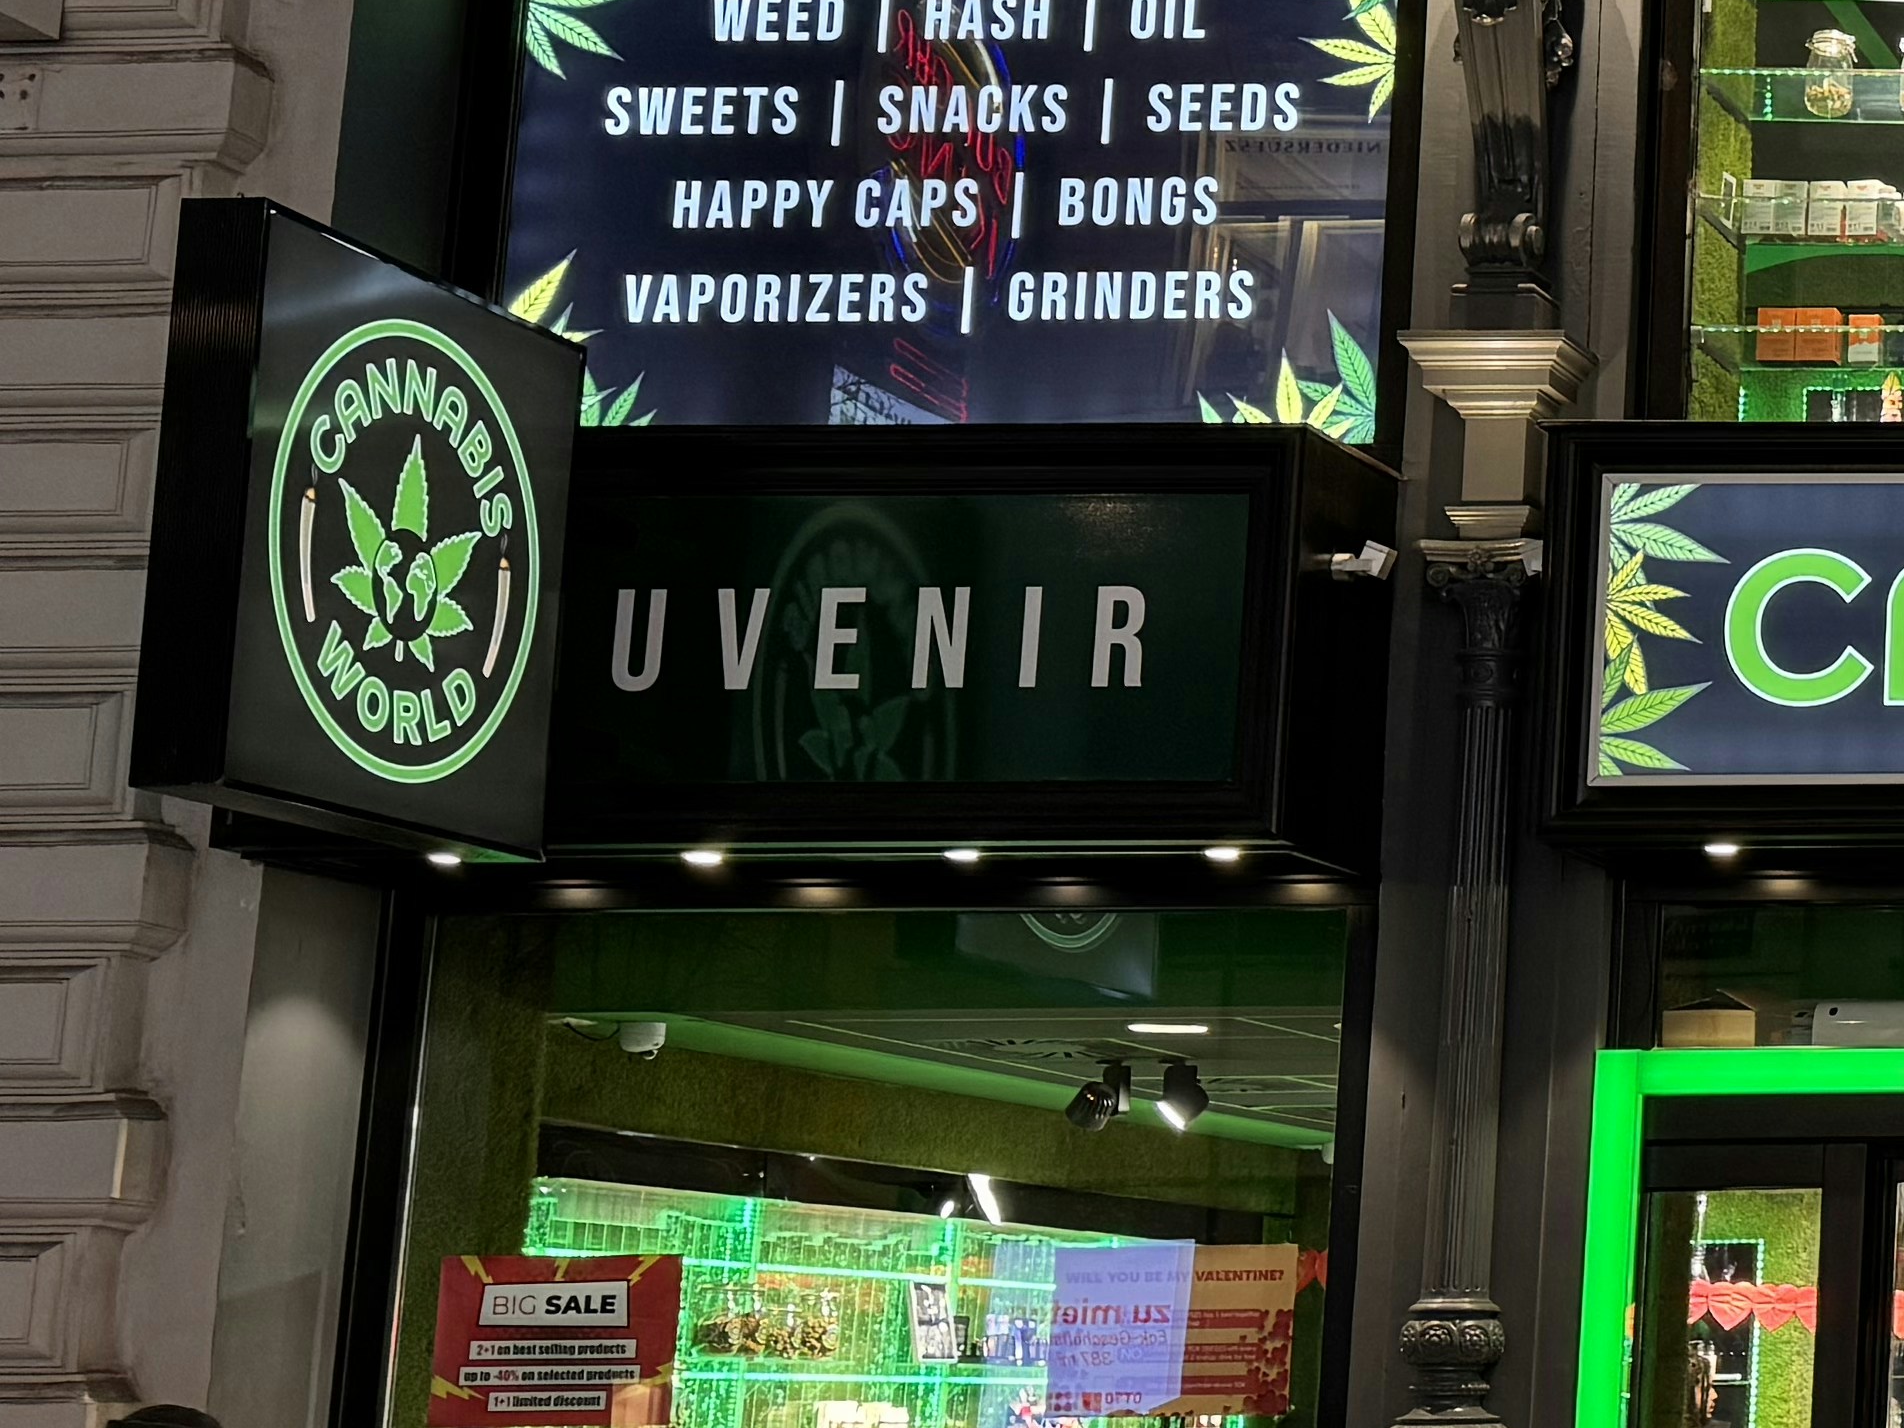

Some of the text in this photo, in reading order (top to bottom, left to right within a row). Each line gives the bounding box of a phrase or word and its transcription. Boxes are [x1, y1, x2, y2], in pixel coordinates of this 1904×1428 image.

[605, 81, 1301, 136] SWEETS SNACKS SEEDS
[673, 175, 1219, 229] HAPPY CAPS BONGS
[624, 268, 1254, 324] VAPORIZERS GRINDERS
[309, 356, 515, 540] CANNABIS
[610, 585, 1147, 693] UVENIR
[316, 619, 479, 746] WORLD
[1195, 1269, 1285, 1282] VALENTINE?
[492, 1294, 617, 1316] BIG SALE
[577, 1343, 627, 1357] products
